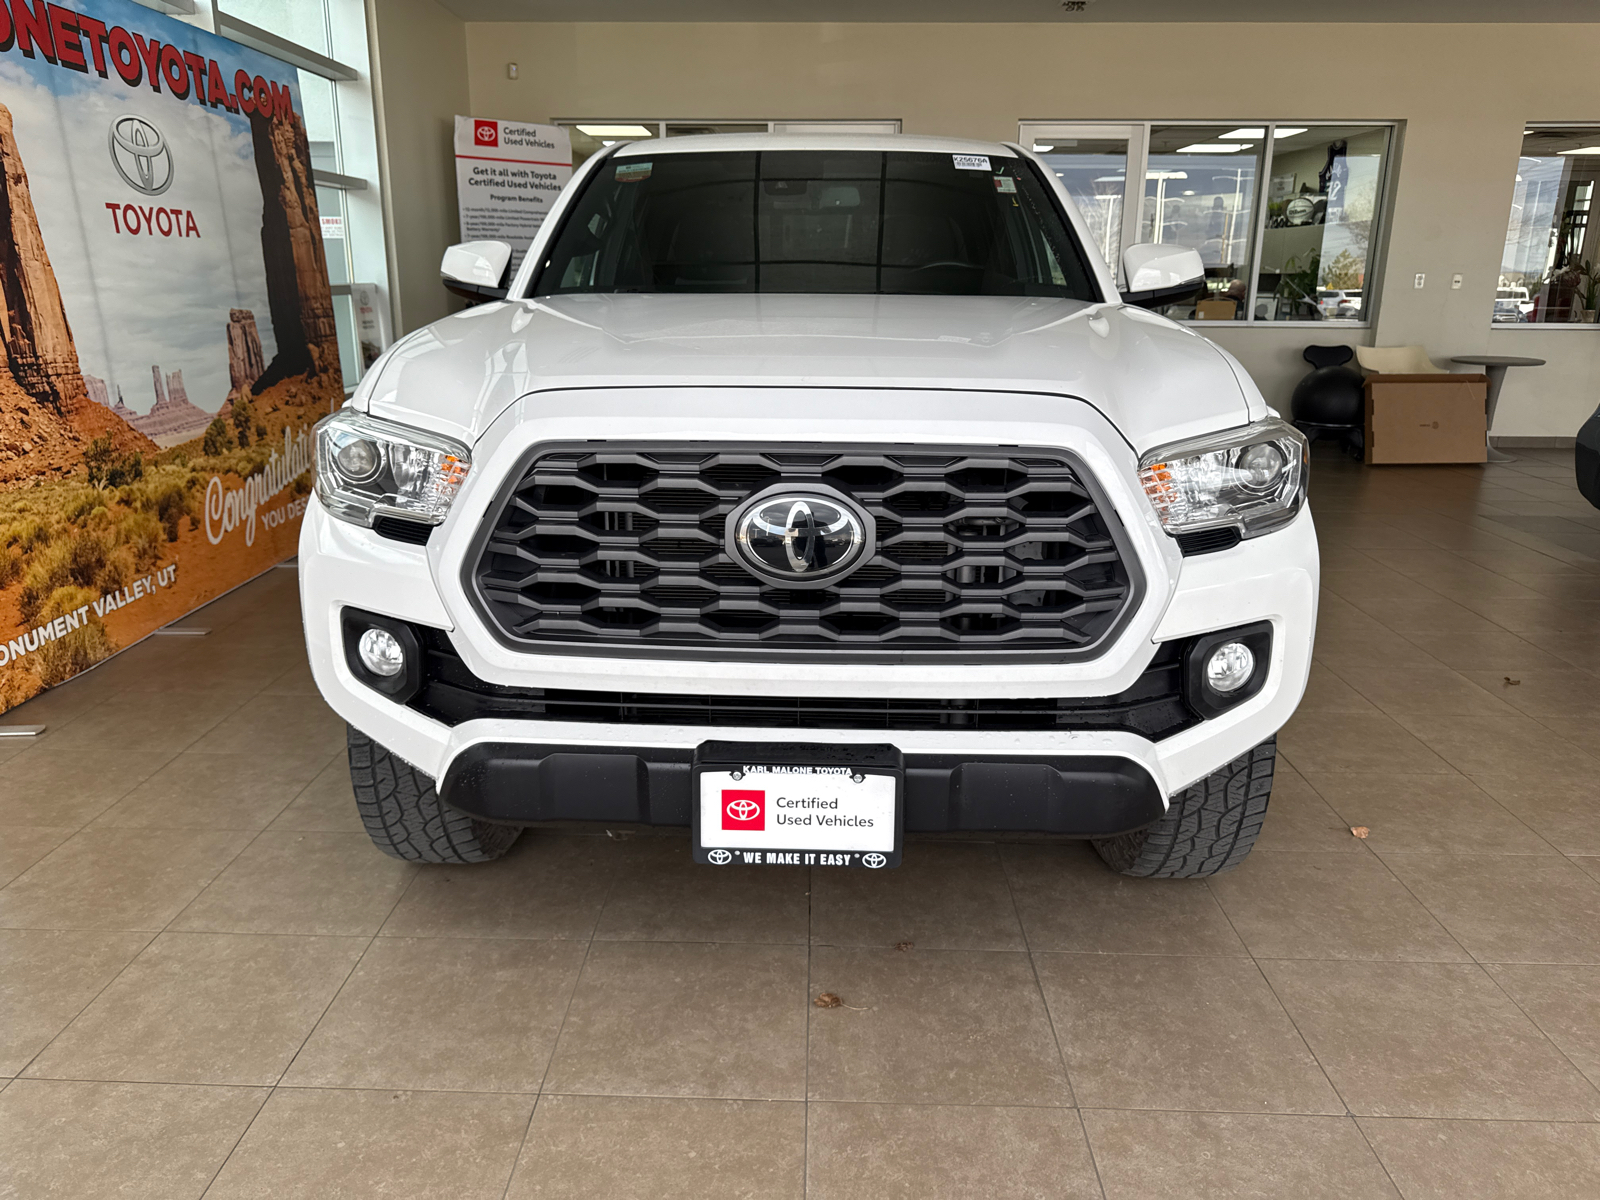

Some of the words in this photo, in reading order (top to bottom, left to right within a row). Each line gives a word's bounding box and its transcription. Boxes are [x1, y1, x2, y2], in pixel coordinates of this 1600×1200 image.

[503, 126, 537, 138] Certified
[503, 137, 523, 146] Used
[524, 138, 555, 149] Vehicles
[473, 166, 489, 176] Get
[490, 167, 497, 177] it
[498, 168, 509, 178] all
[510, 169, 529, 179] with
[530, 170, 557, 181] Toyota
[468, 177, 506, 188] Certified
[507, 180, 528, 189] Used
[529, 181, 562, 192] Vehicles
[490, 194, 517, 203] Program
[518, 195, 543, 204] Benefits
[105, 202, 201, 238] TOYOTA
[205, 423, 311, 547] Congratulati
[261, 507, 286, 531] YOU
[92, 575, 157, 618] VALLEY,
[158, 564, 177, 587] UT
[742, 765, 769, 774] KARL
[772, 766, 813, 775] MALONE
[815, 767, 853, 776] TOYOTA
[776, 796, 839, 810] Certified
[776, 813, 812, 826] Used
[816, 814, 874, 828] Vehicles
[743, 851, 762, 864] WE
[766, 852, 800, 865] MAKE
[804, 853, 816, 865] IT
[820, 853, 851, 866] EASY
